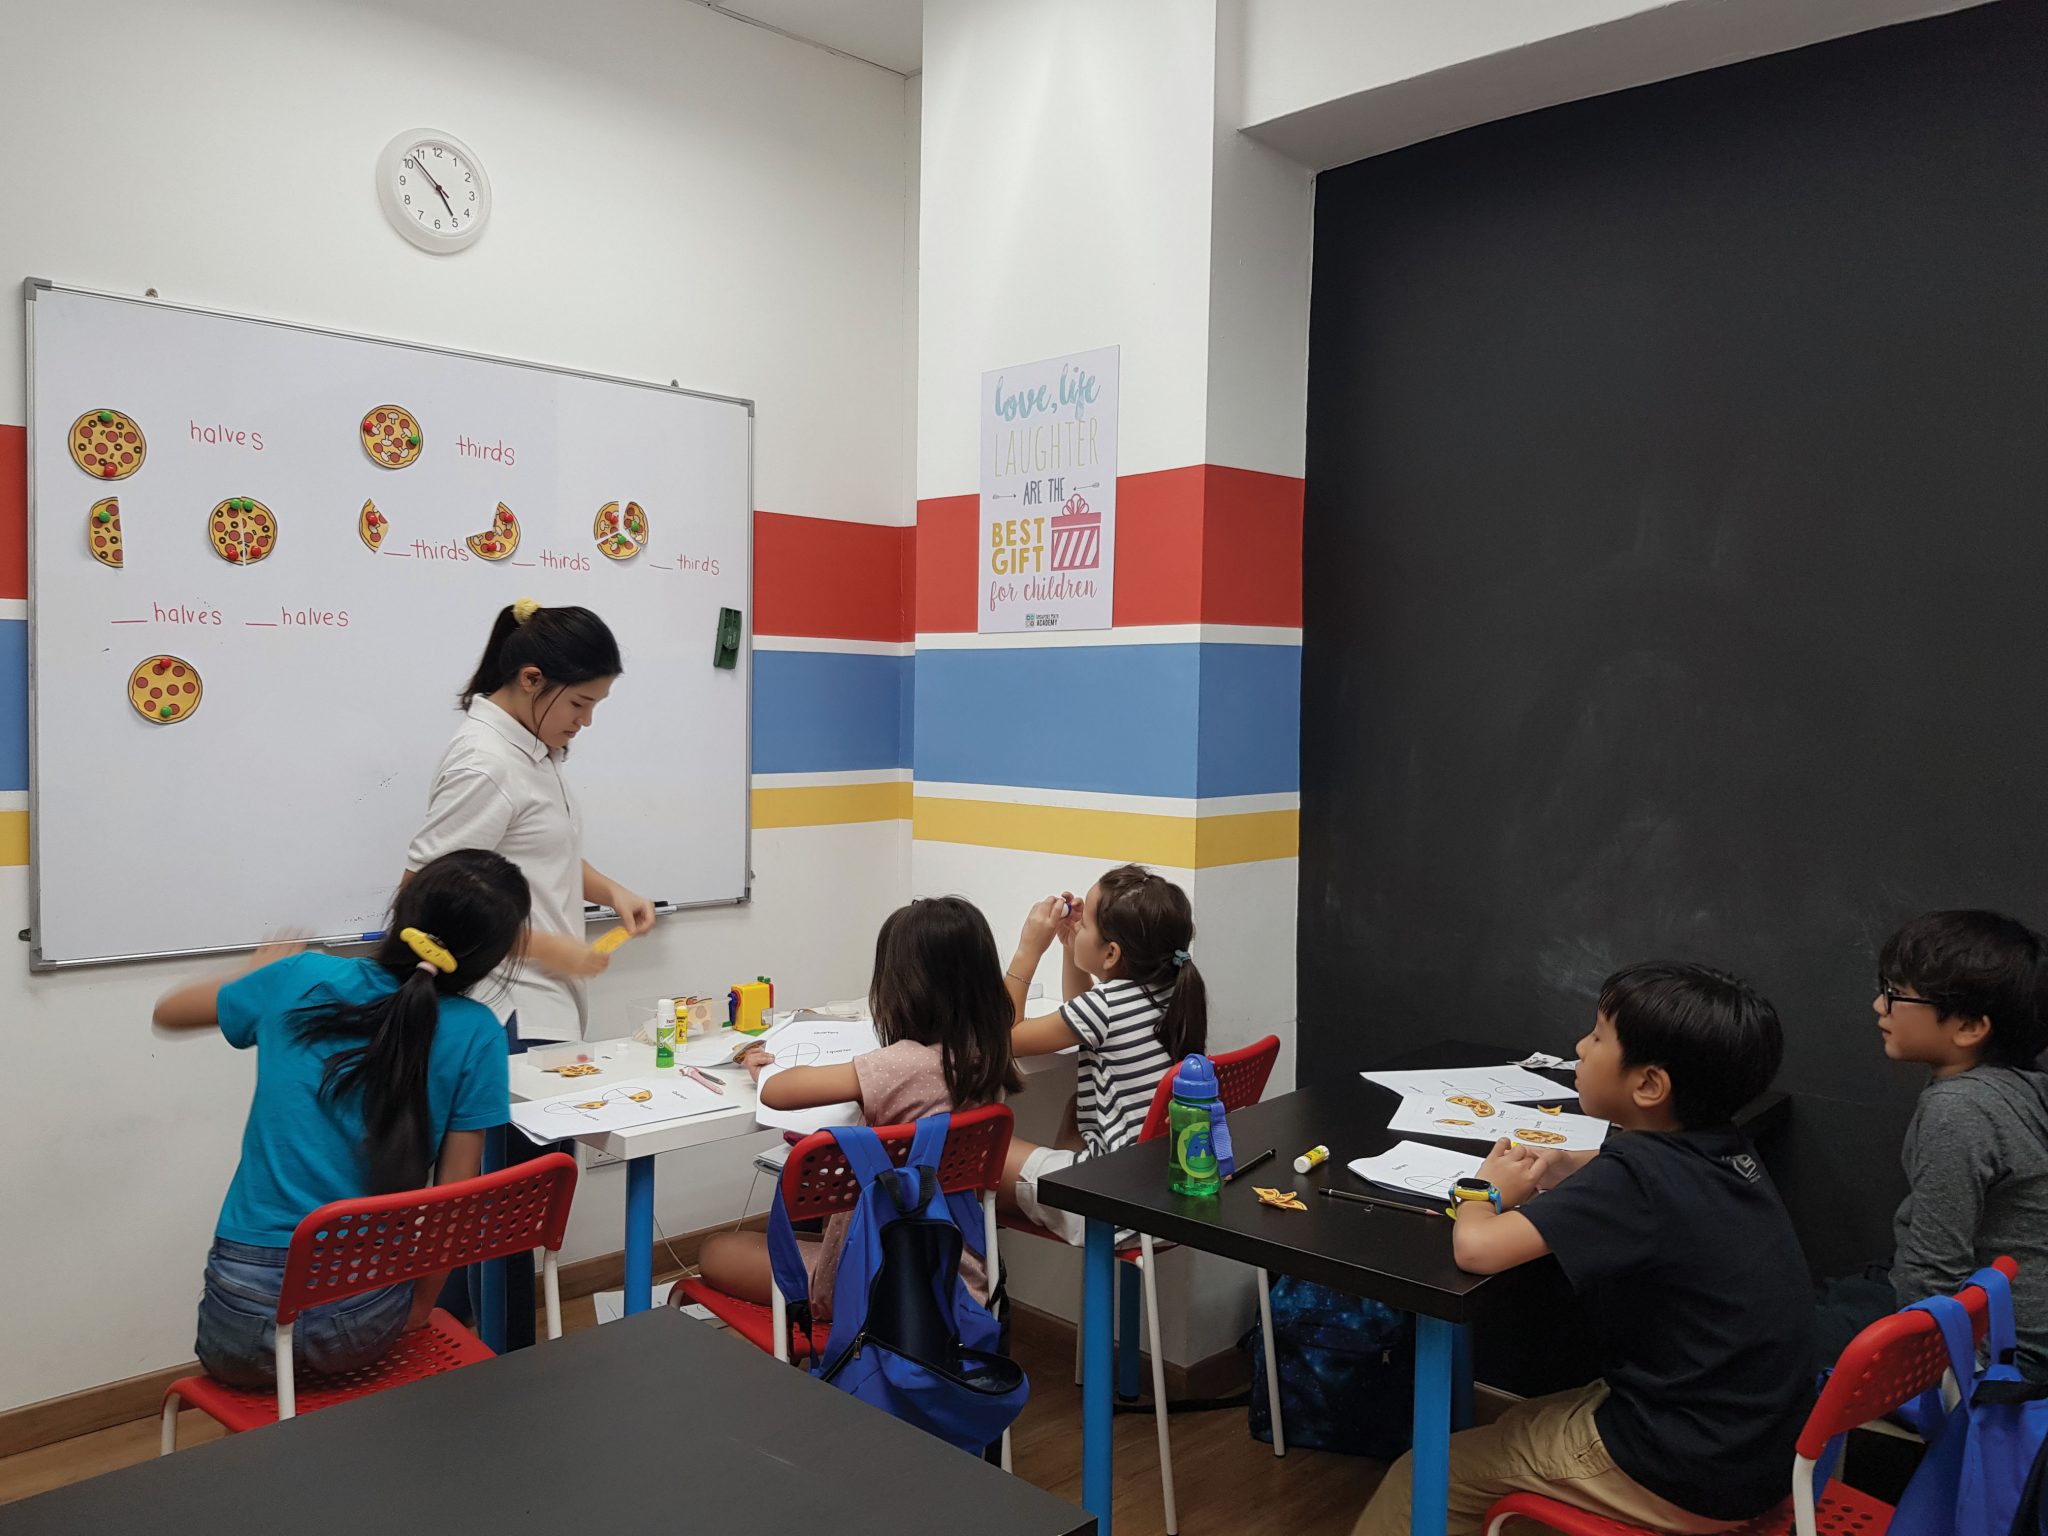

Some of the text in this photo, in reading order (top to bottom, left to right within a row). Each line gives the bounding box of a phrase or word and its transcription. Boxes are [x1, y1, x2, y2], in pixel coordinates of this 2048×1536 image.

[416, 149, 425, 160] 11
[432, 147, 443, 159] 12
[403, 158, 414, 169] 10
[453, 157, 458, 167] 1
[399, 175, 406, 186] 9
[464, 172, 471, 183] 2
[404, 194, 411, 205] 8
[469, 191, 475, 201] 3
[417, 209, 424, 221] 7
[463, 208, 470, 218] 4
[434, 219, 441, 229] 6
[451, 217, 459, 228] 5
[1058, 362, 1100, 421] life
[190, 419, 264, 451] halves
[456, 434, 516, 466] thirds
[994, 416, 1099, 478] LAUGHTER
[1023, 477, 1066, 506] ARE THE
[991, 516, 1046, 548] BEST
[410, 538, 470, 563] thirds
[539, 548, 591, 572] thirds
[676, 554, 720, 576] thirds
[991, 545, 1044, 575] GIFT
[989, 571, 1098, 611] for children
[153, 601, 349, 628] halves halves
[1036, 619, 1058, 627] ACADEMY
